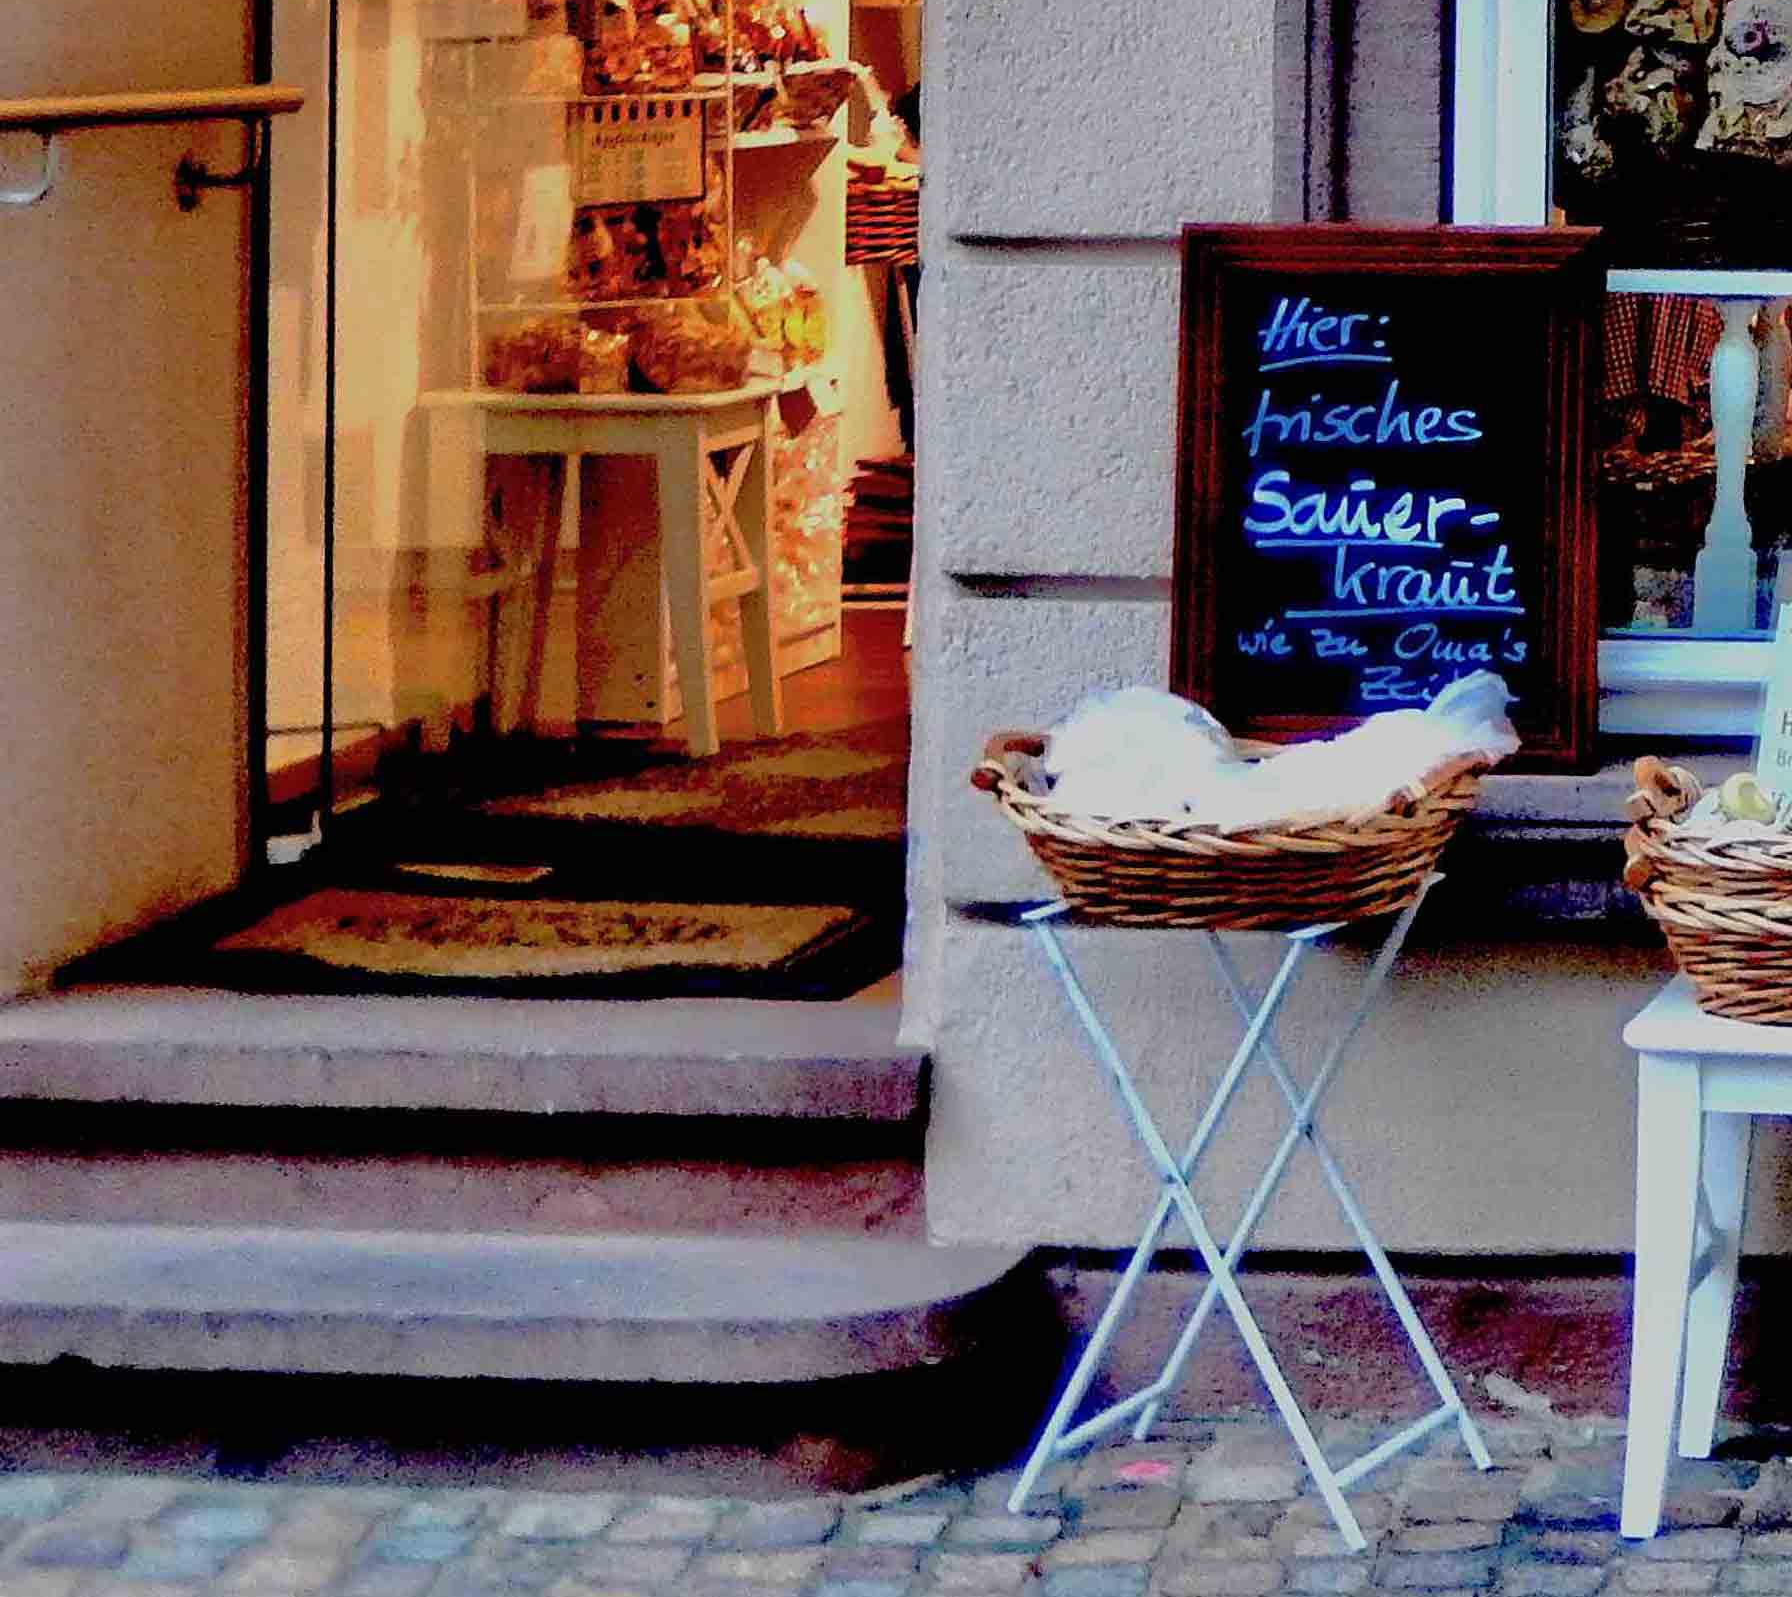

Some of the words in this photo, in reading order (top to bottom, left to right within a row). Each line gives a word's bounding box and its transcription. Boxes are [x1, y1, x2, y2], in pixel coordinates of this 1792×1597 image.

[1257, 296, 1390, 351] Hier:
[1242, 379, 1484, 456] frisches
[1333, 545, 1517, 604] kraut
[1238, 618, 1293, 657] wie
[1394, 622, 1528, 662] Oma's
[1360, 666, 1460, 701] Zei
